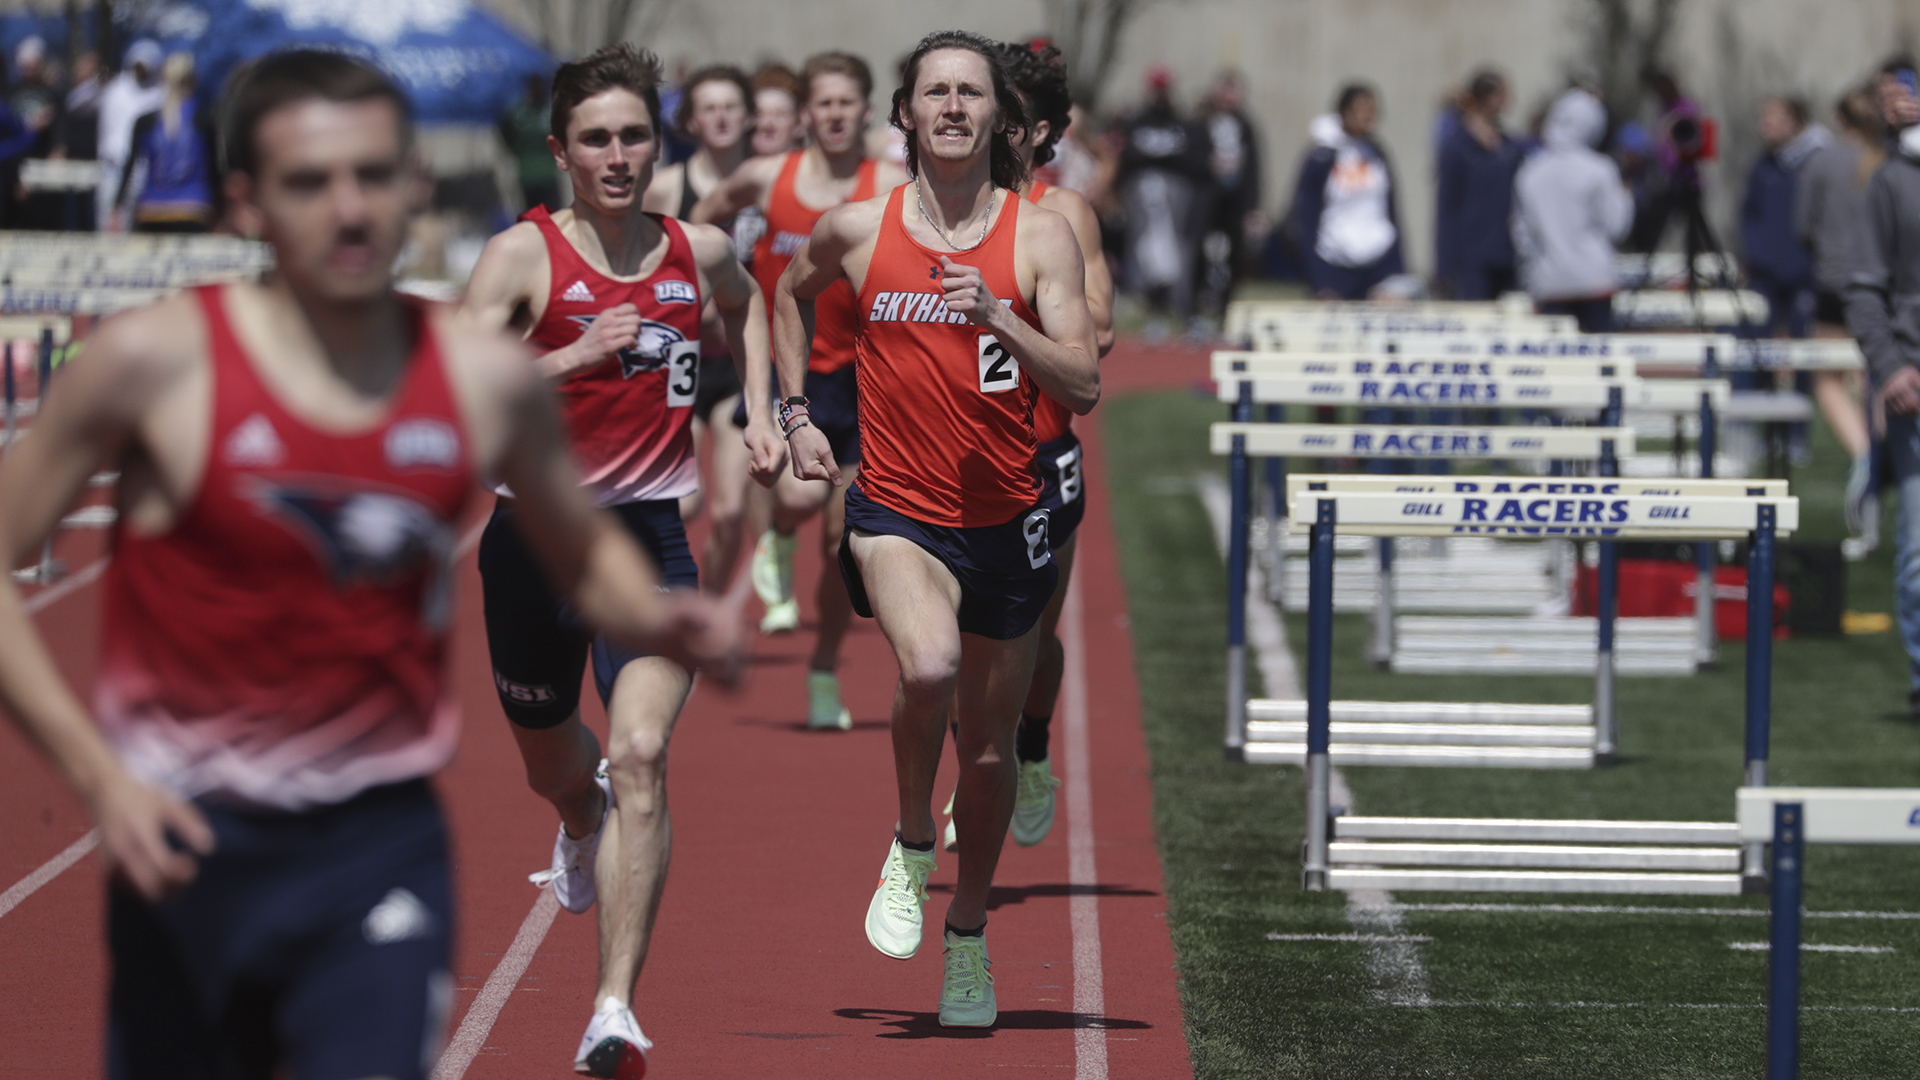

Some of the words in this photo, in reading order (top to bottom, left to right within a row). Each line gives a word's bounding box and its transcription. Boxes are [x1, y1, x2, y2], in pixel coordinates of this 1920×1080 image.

[657, 282, 696, 300] USI
[869, 291, 1014, 326] SKYHA
[673, 352, 698, 396] 3
[982, 342, 1013, 384] 2
[1361, 381, 1497, 399] RACERS
[1353, 433, 1490, 451] RACERS
[1402, 503, 1444, 516] GILL
[1462, 499, 1630, 523] RACERS
[1648, 506, 1691, 519] GILL
[1028, 517, 1048, 560] 2
